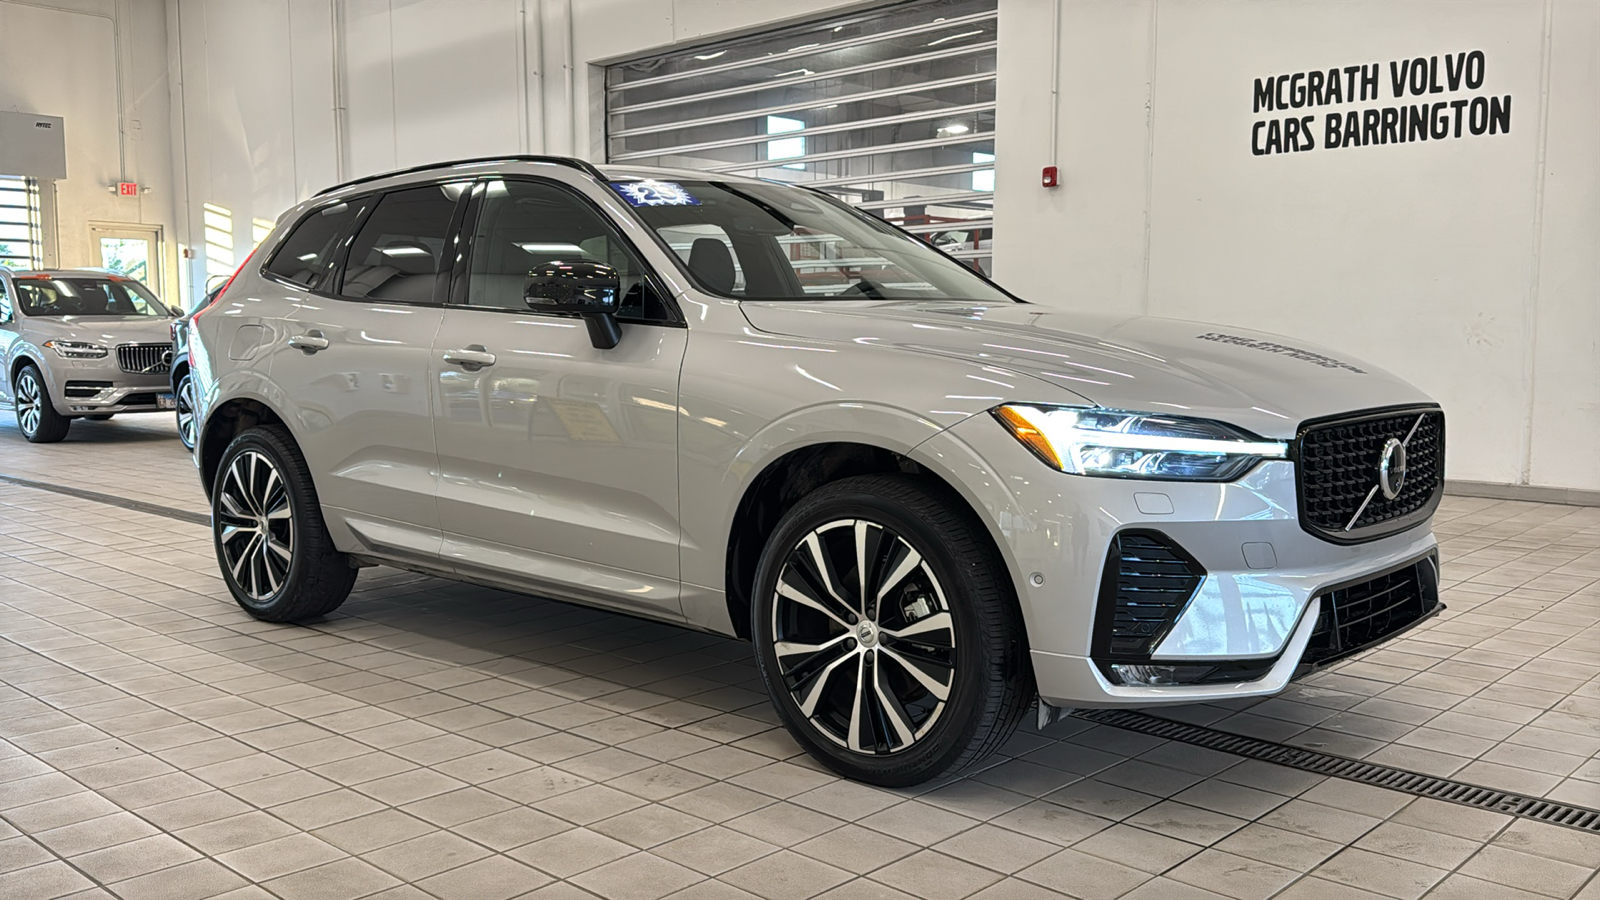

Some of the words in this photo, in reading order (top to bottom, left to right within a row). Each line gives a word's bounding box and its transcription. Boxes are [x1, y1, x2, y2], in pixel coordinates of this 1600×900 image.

[1253, 63, 1379, 113] MCGRATH
[1389, 50, 1485, 98] VOLVO
[1252, 115, 1315, 156] CARS
[1324, 95, 1511, 149] BARRINGTON
[120, 182, 137, 196] EXIT
